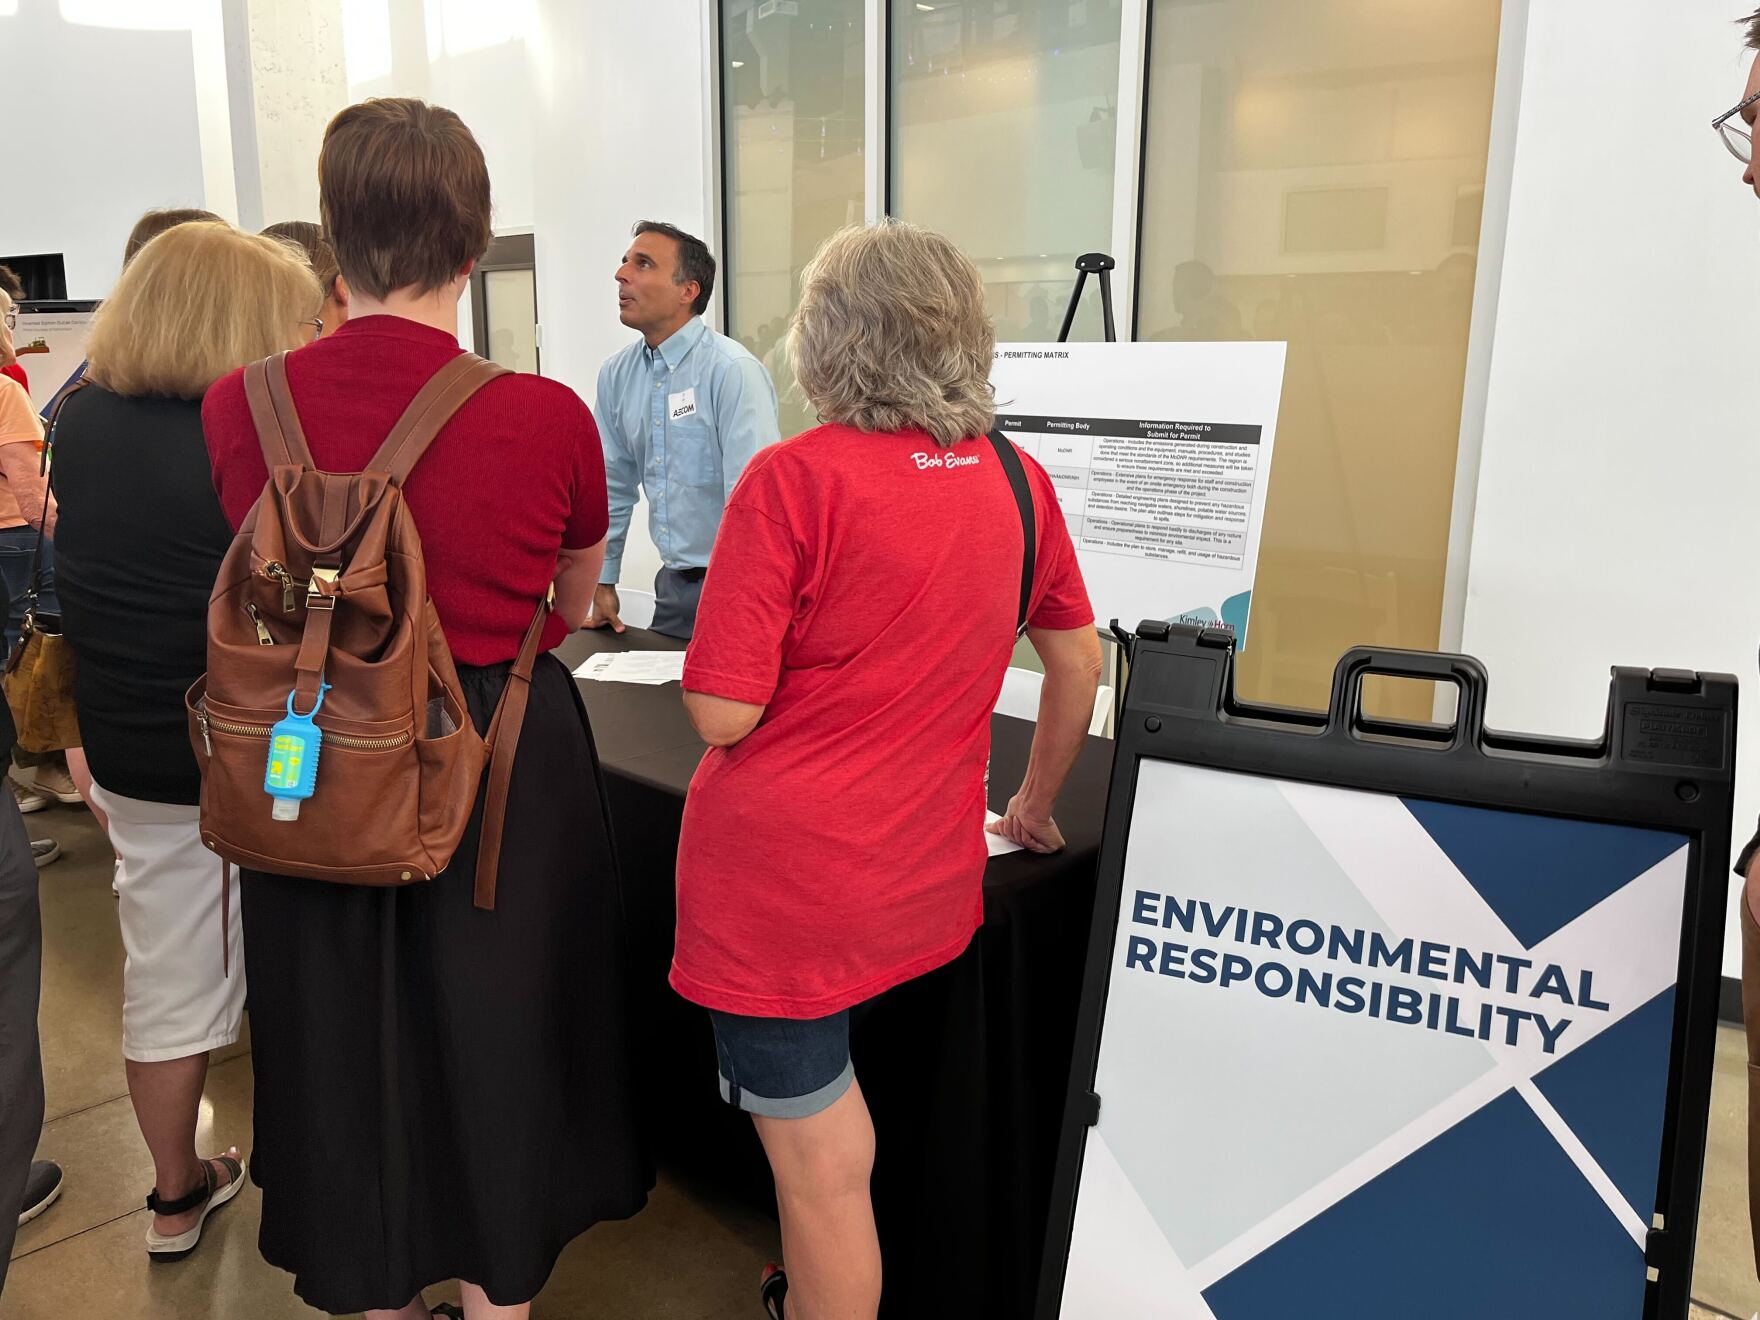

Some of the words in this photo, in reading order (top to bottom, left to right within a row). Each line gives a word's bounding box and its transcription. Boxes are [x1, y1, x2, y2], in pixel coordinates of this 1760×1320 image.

[673, 404, 694, 418] AECOM
[1047, 421, 1074, 429] Permitting
[1076, 422, 1089, 430] Body
[910, 452, 943, 469] Bob
[944, 452, 979, 468] Evans
[1180, 614, 1206, 627] Kimley
[1132, 889, 1610, 1012] ENVIRONMENTAL
[1125, 935, 1572, 1055] RESPONSIBILITY
